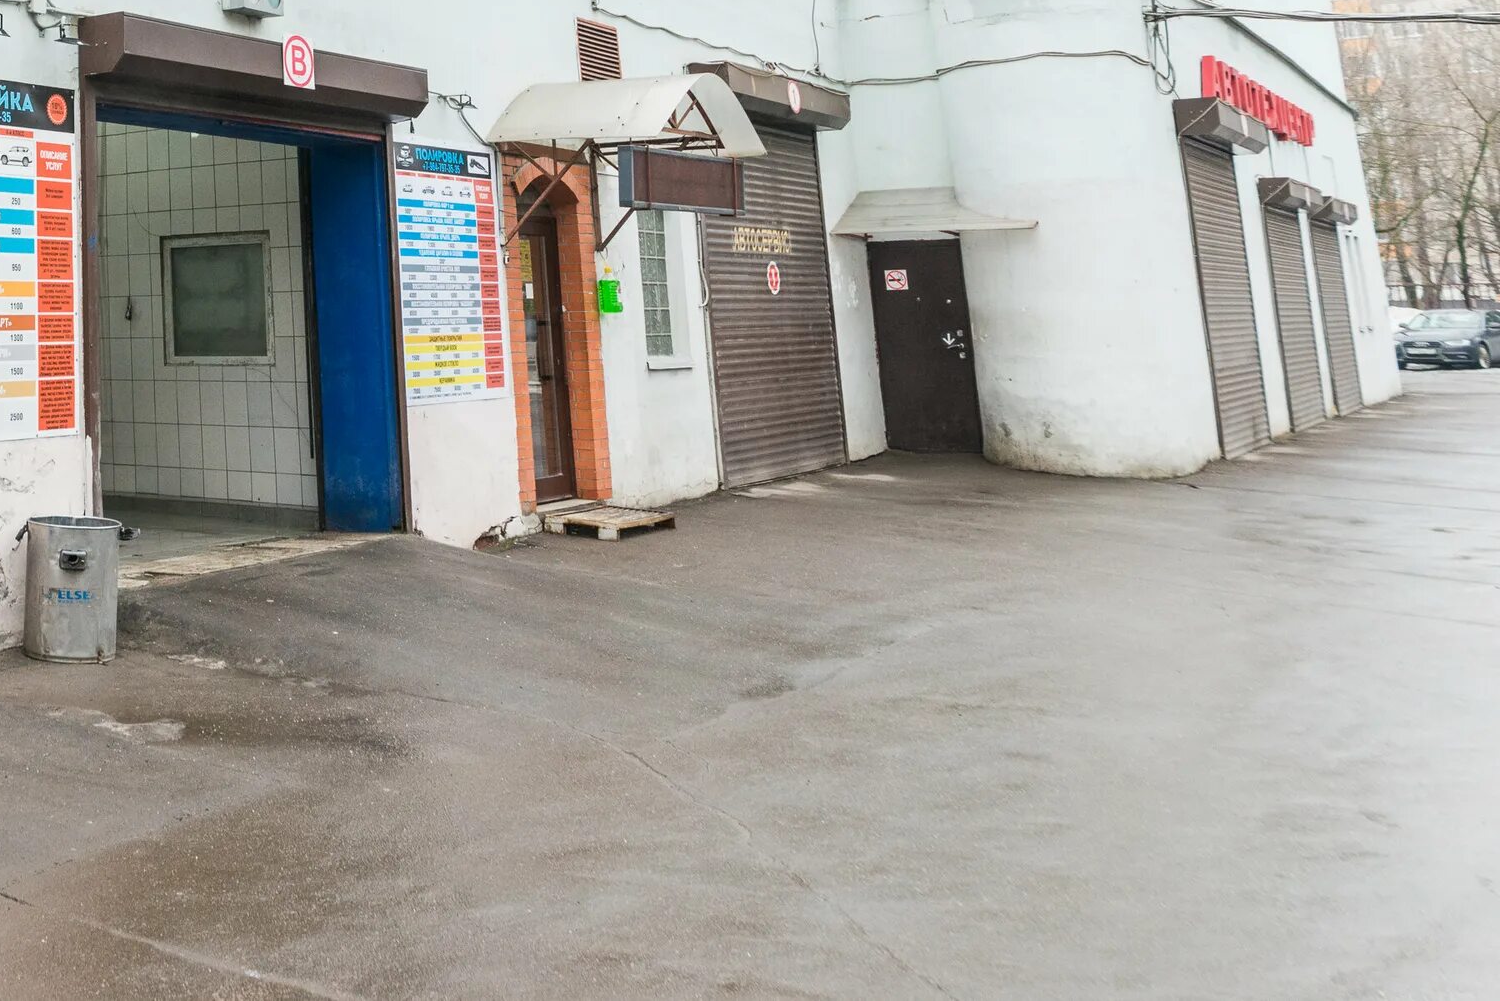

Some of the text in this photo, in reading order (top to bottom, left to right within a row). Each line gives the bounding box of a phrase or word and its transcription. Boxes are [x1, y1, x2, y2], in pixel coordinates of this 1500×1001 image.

[415, 148, 464, 165] ПОЛИРОВКА
[12, 263, 21, 271] 950
[10, 302, 23, 310] 1100
[10, 334, 23, 342] 1300
[10, 413, 23, 421] 2500
